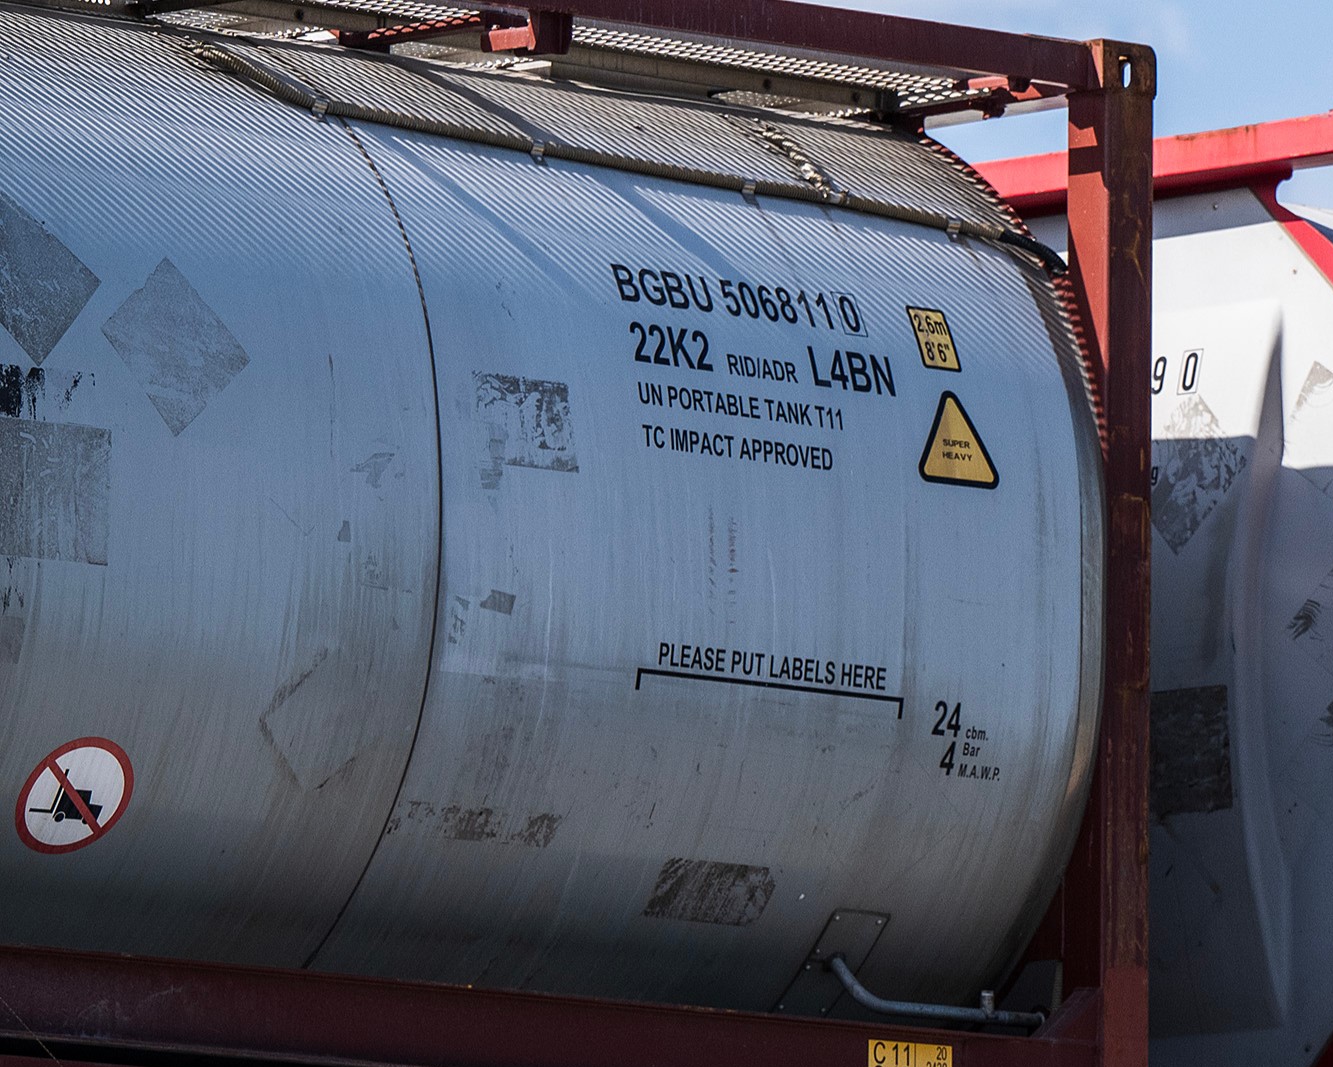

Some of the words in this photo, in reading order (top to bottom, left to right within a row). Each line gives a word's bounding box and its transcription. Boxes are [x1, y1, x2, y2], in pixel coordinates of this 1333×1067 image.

[611, 264, 713, 313] BGBU
[629, 321, 714, 372] 22K2
[727, 354, 798, 384] RID/ADR
[807, 346, 897, 397] L4BN
[1182, 352, 1199, 391] 0
[638, 381, 663, 406] UN
[667, 386, 761, 419] PORTABLE
[764, 398, 812, 427] TANK
[814, 406, 844, 431] T11
[642, 424, 665, 448] TC
[670, 428, 734, 458] IMPACT
[739, 437, 833, 471] APPROVED
[942, 438, 971, 449] SUPER
[942, 452, 973, 462] HEAVY
[658, 642, 725, 674] PLEASE
[730, 650, 766, 678] PUT
[768, 653, 836, 686] LABELS
[840, 662, 887, 692] HERE
[931, 700, 961, 738] 24
[965, 726, 989, 741] cbm.
[939, 741, 956, 776] 4
[962, 742, 981, 757] Bar
[957, 763, 1000, 781] M.A.W.P.
[873, 1041, 886, 1064] C
[892, 1043, 910, 1067] 11
[936, 1046, 948, 1061] 20
